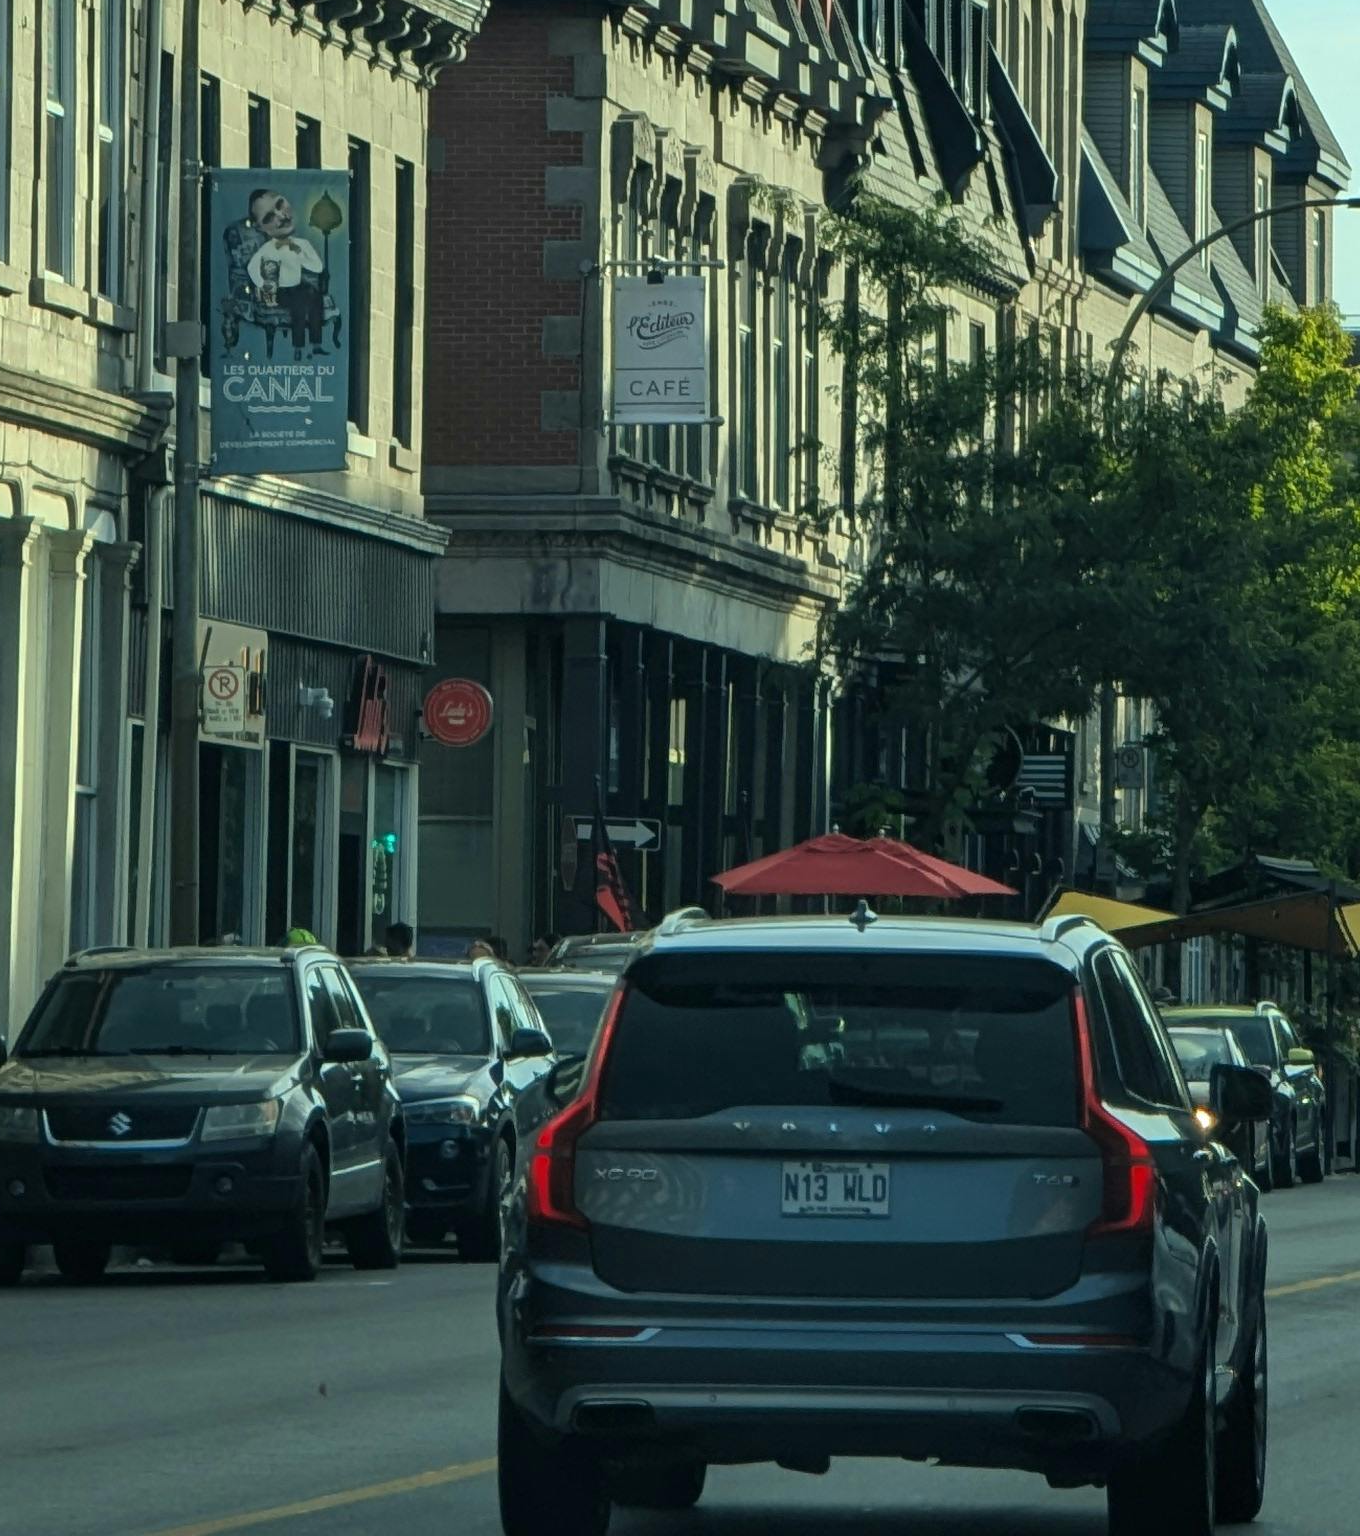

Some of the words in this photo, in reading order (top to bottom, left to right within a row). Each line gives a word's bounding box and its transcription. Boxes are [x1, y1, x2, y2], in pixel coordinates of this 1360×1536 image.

[224, 365, 245, 376] LES
[248, 365, 314, 376] QUARTIERS
[318, 366, 335, 375] DU
[223, 376, 334, 402] CANAL
[630, 376, 690, 396] CAFÉ
[784, 1173, 828, 1202] N13
[843, 1173, 887, 1202] WLD
